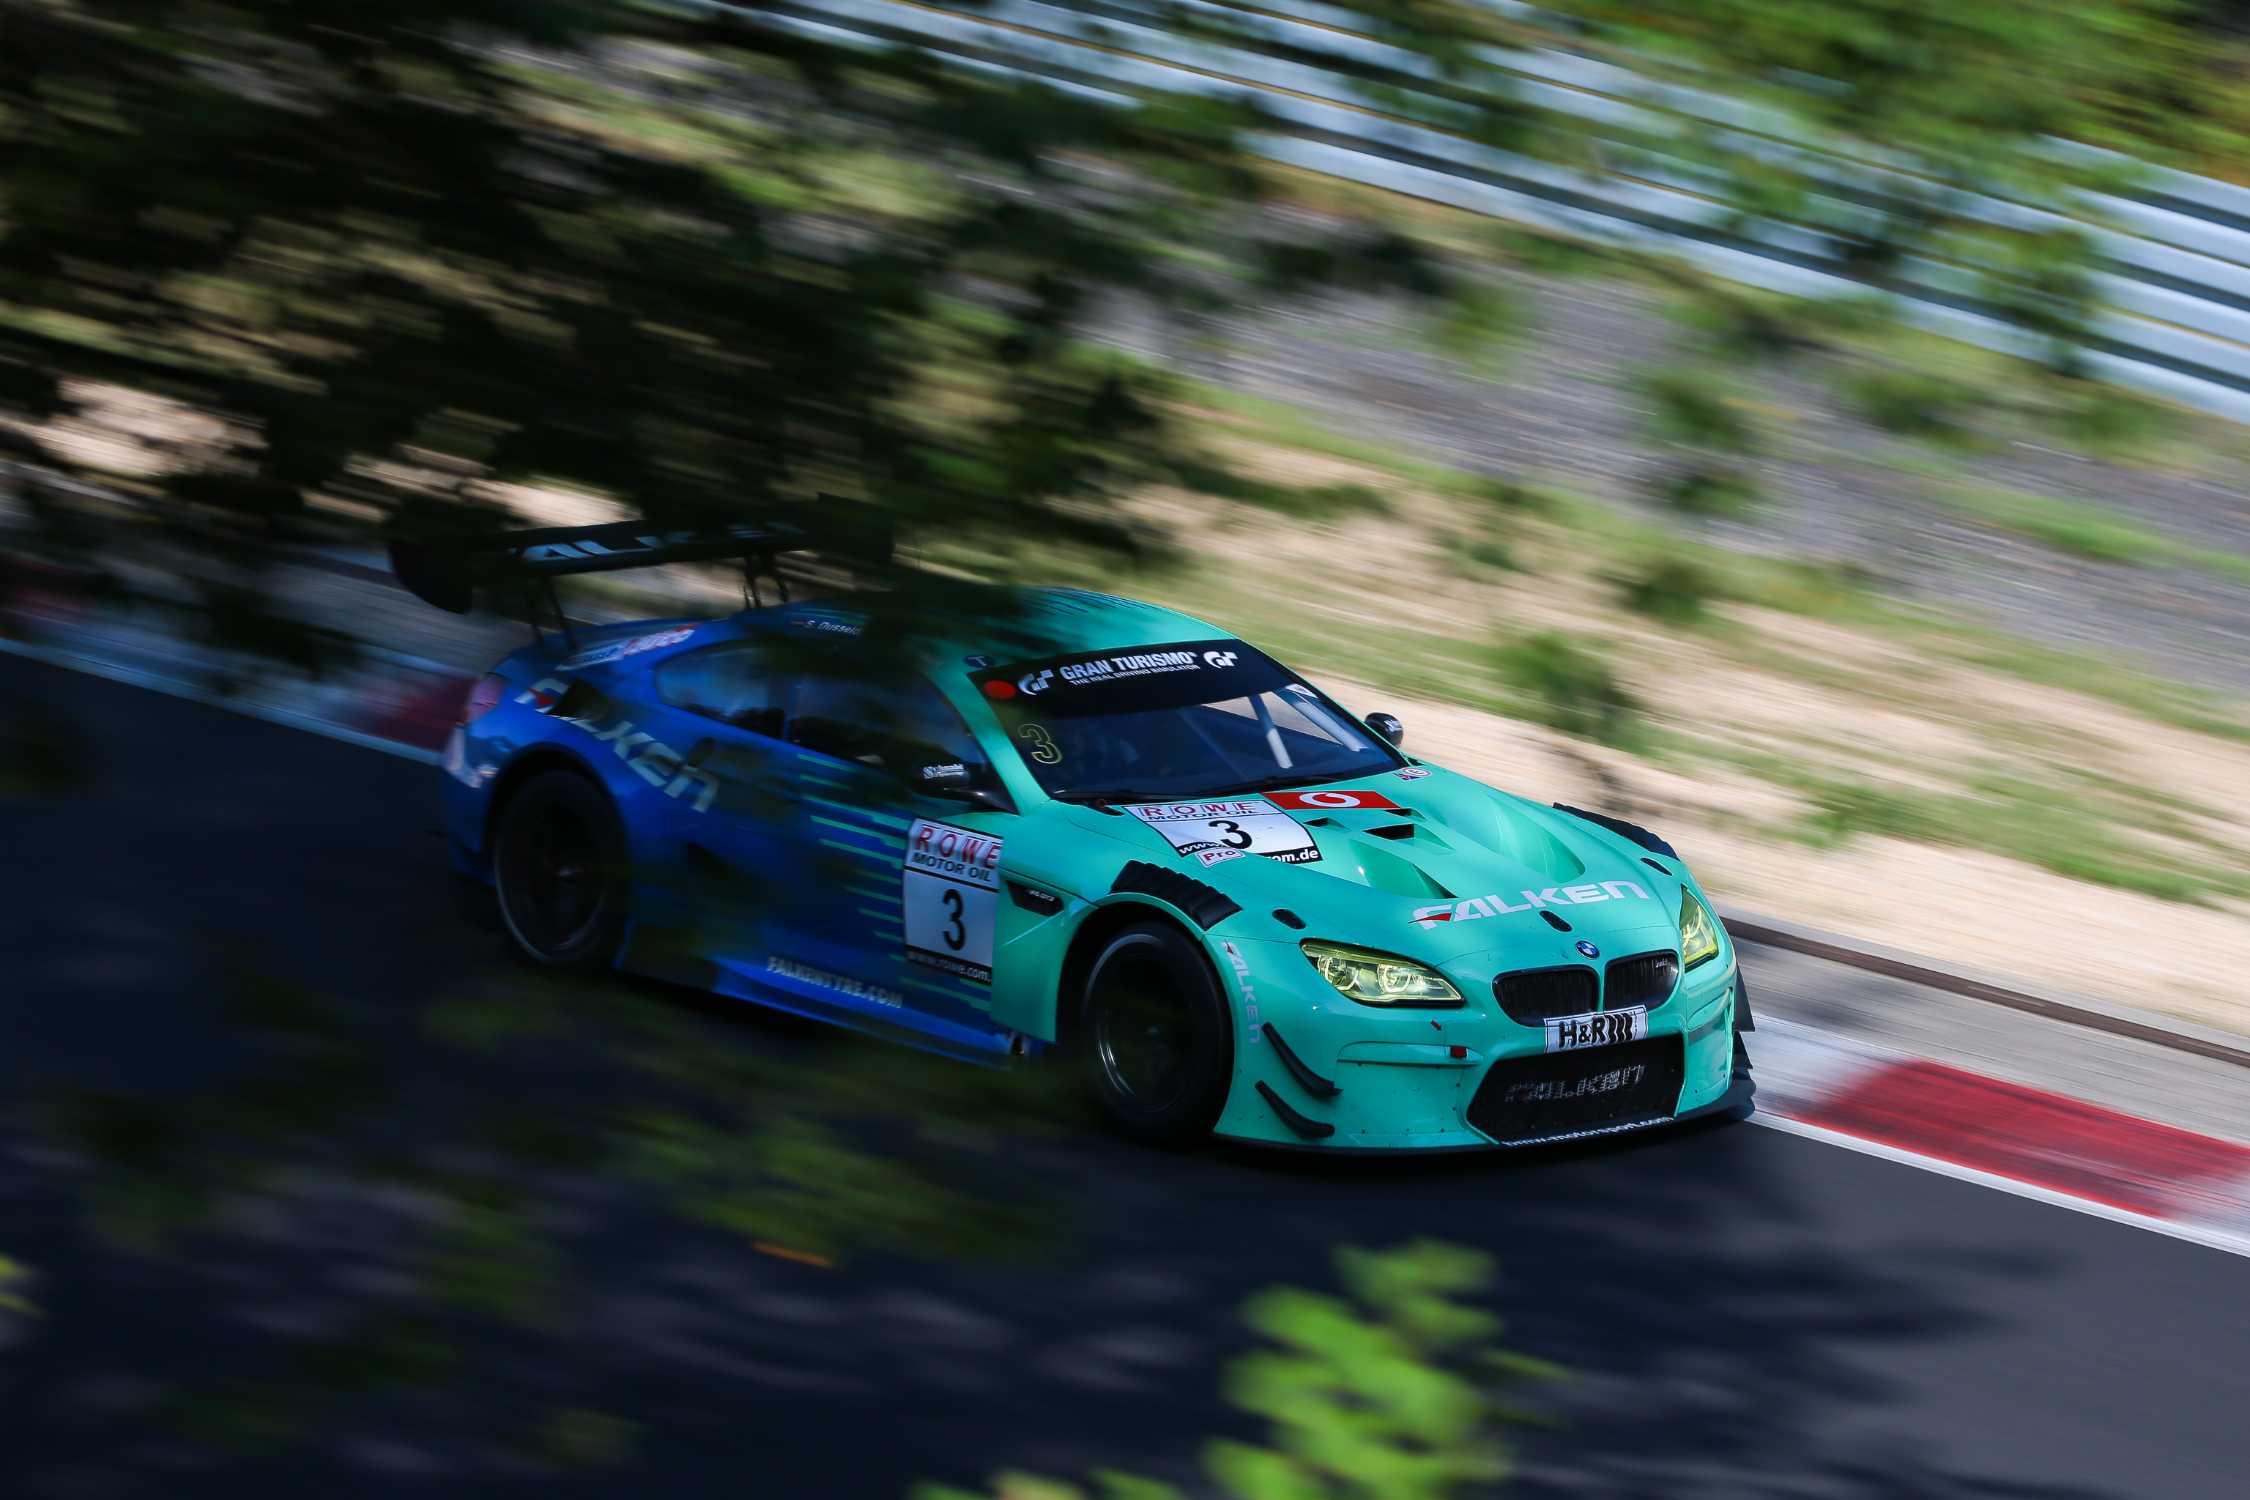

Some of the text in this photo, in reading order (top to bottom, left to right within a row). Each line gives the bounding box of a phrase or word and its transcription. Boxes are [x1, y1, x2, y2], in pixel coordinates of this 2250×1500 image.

[1060, 659, 1114, 680] GRAN
[1017, 722, 1064, 765] 3
[1143, 802, 1256, 817] ROWE
[915, 825, 1000, 870] ROWE
[1208, 819, 1253, 850] 3
[911, 852, 992, 883] MOTOR OIL
[1203, 849, 1236, 862] Pro
[942, 888, 966, 951] 3
[1412, 880, 1649, 930] FALKEN
[1222, 940, 1261, 1043] FALKEN
